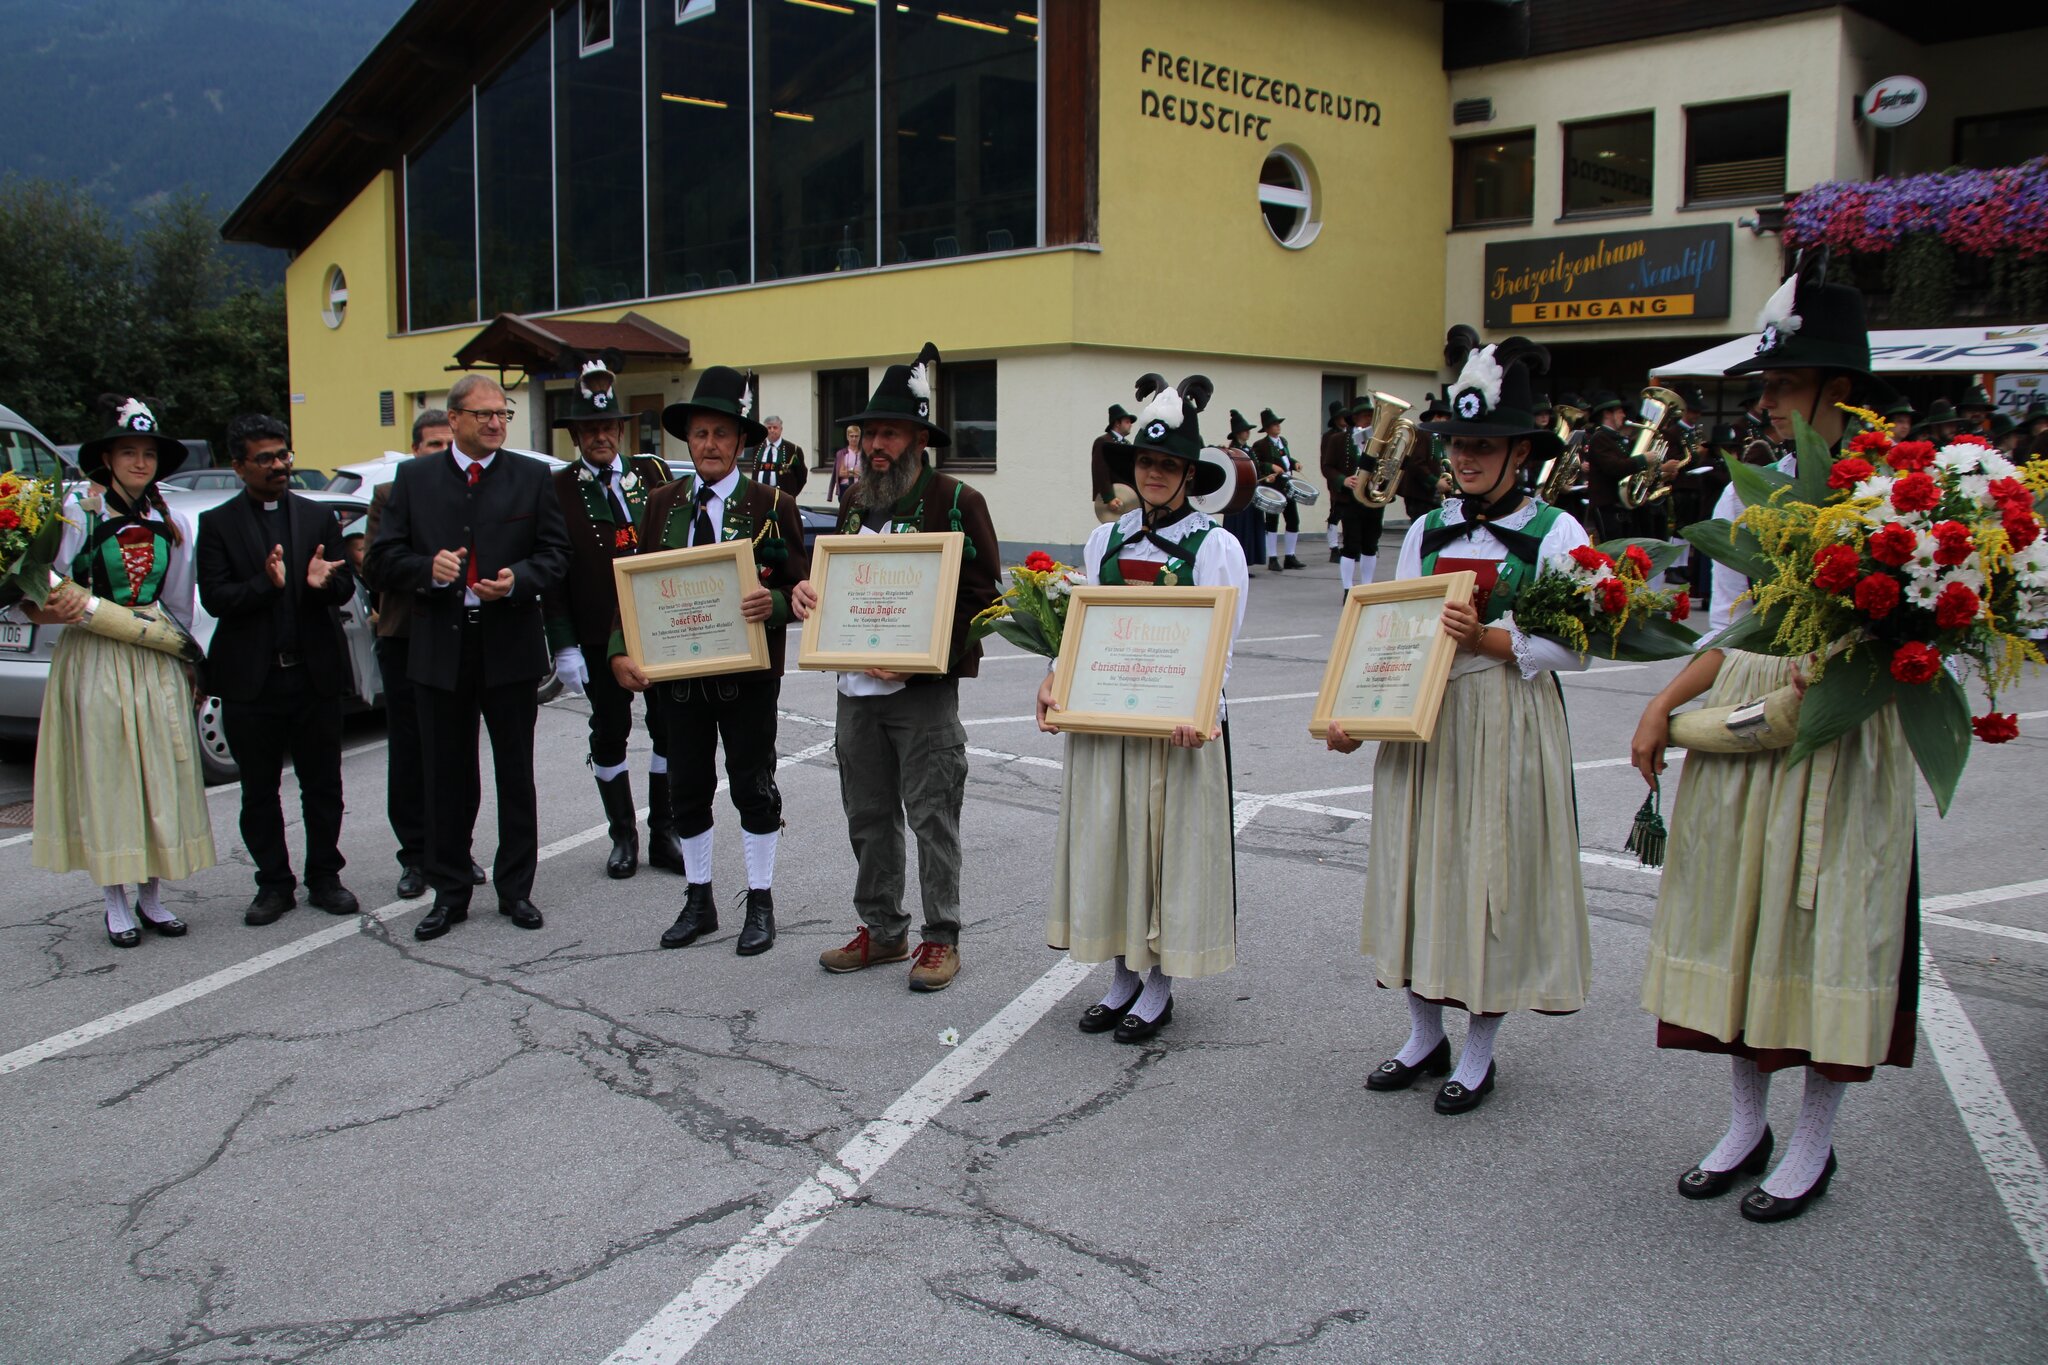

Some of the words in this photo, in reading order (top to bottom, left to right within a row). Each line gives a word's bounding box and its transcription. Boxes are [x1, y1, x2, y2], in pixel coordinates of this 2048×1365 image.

[1141, 47, 1381, 127] FREIZEITZENTRUM
[1490, 239, 1647, 302] Freizeitzentrum
[1628, 239, 1718, 291] Neustift
[1534, 299, 1668, 320] EINGANG
[1090, 660, 1130, 673] Christina
